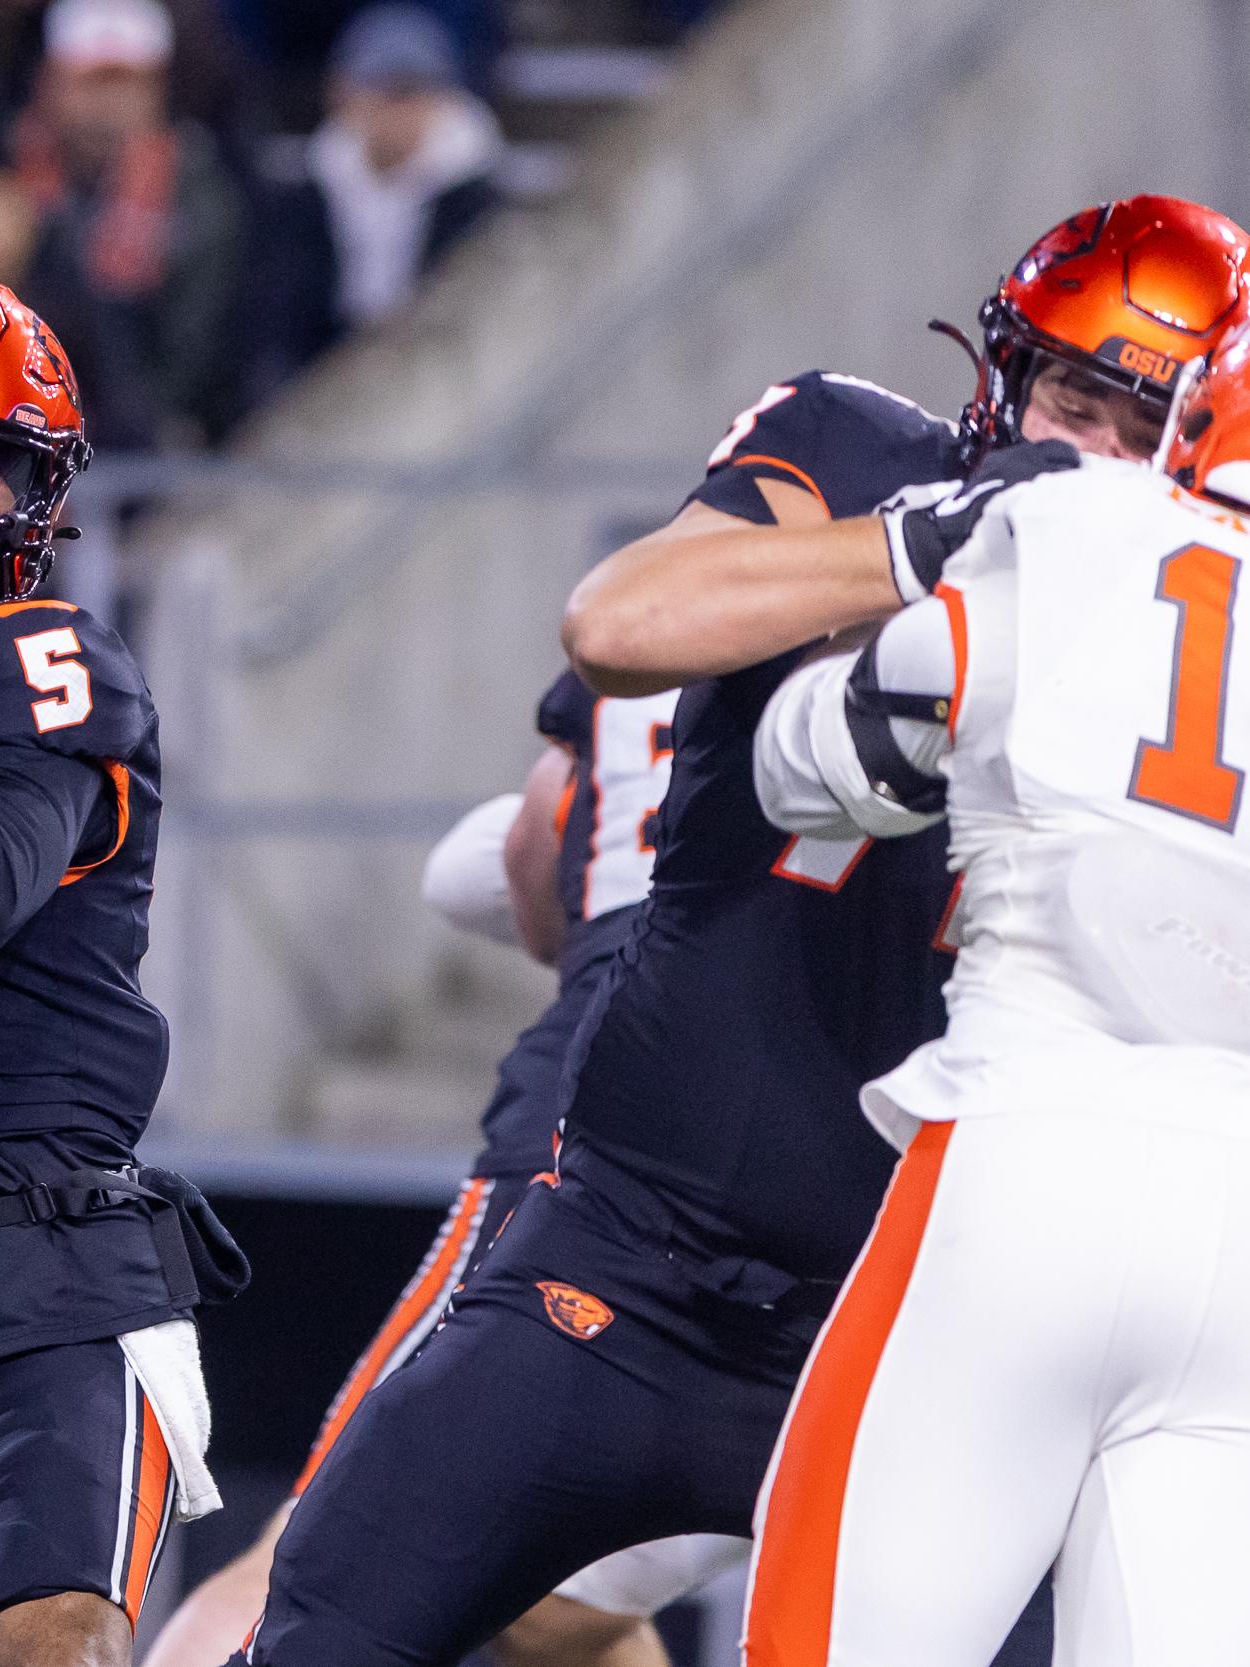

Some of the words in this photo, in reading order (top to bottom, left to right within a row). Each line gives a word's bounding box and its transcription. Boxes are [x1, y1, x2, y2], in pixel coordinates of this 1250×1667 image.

[1118, 343, 1177, 384] OSU
[15, 408, 47, 428] BEAVS
[13, 626, 93, 734] 5
[1126, 541, 1245, 836] 1
